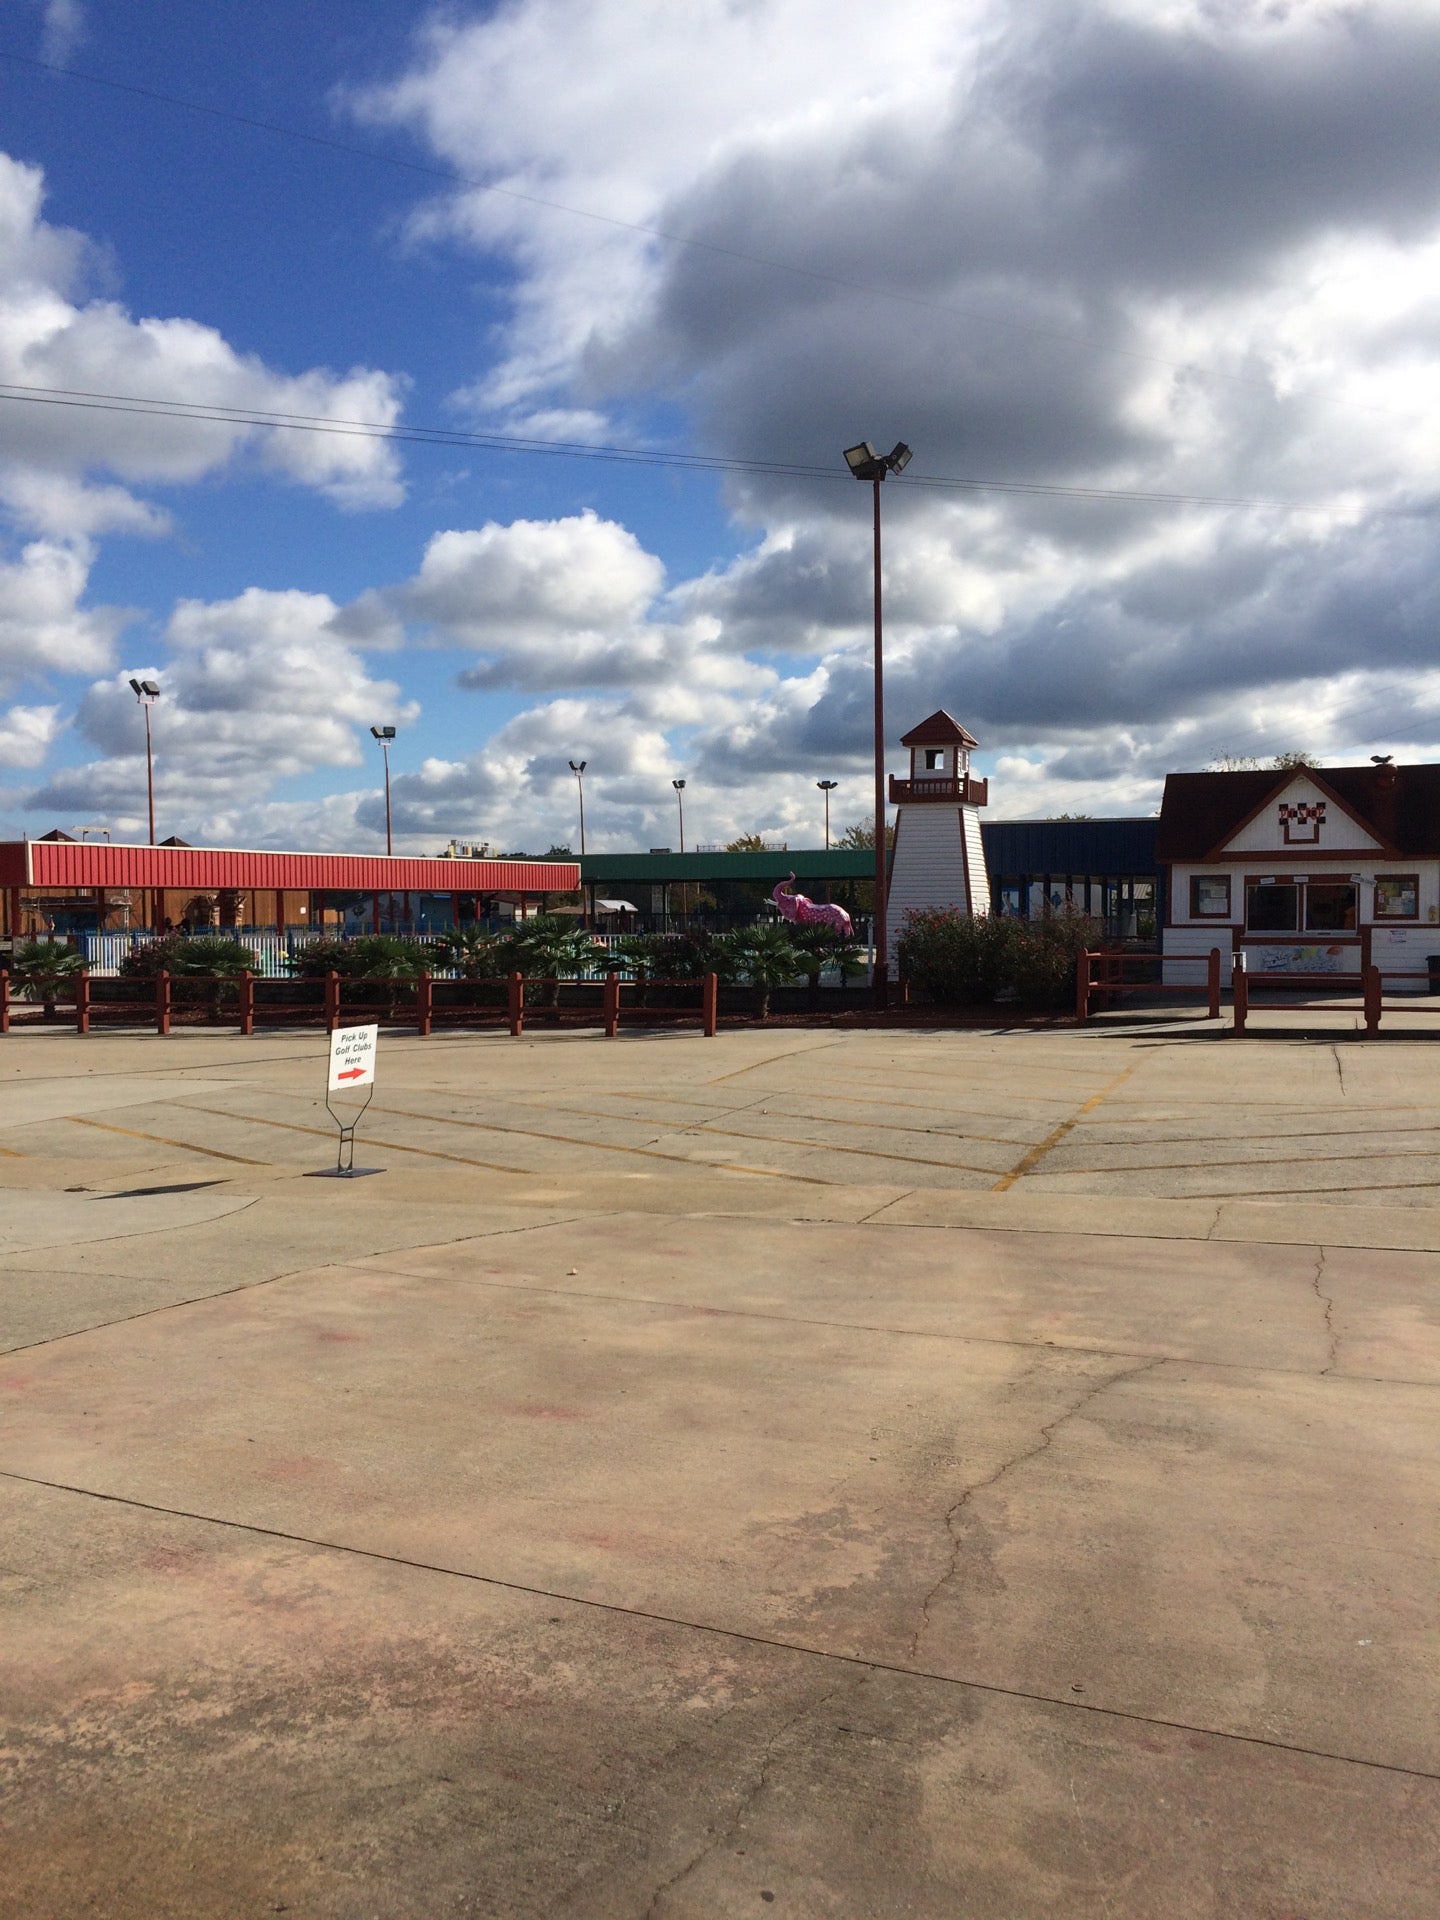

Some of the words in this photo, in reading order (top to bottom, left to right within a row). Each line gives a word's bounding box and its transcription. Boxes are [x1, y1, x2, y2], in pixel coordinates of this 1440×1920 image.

[341, 1032, 357, 1042] Pick
[358, 1031, 368, 1041] Up
[335, 1045, 350, 1055] Golf
[353, 1043, 372, 1052] Clubs
[344, 1056, 362, 1065] Here
